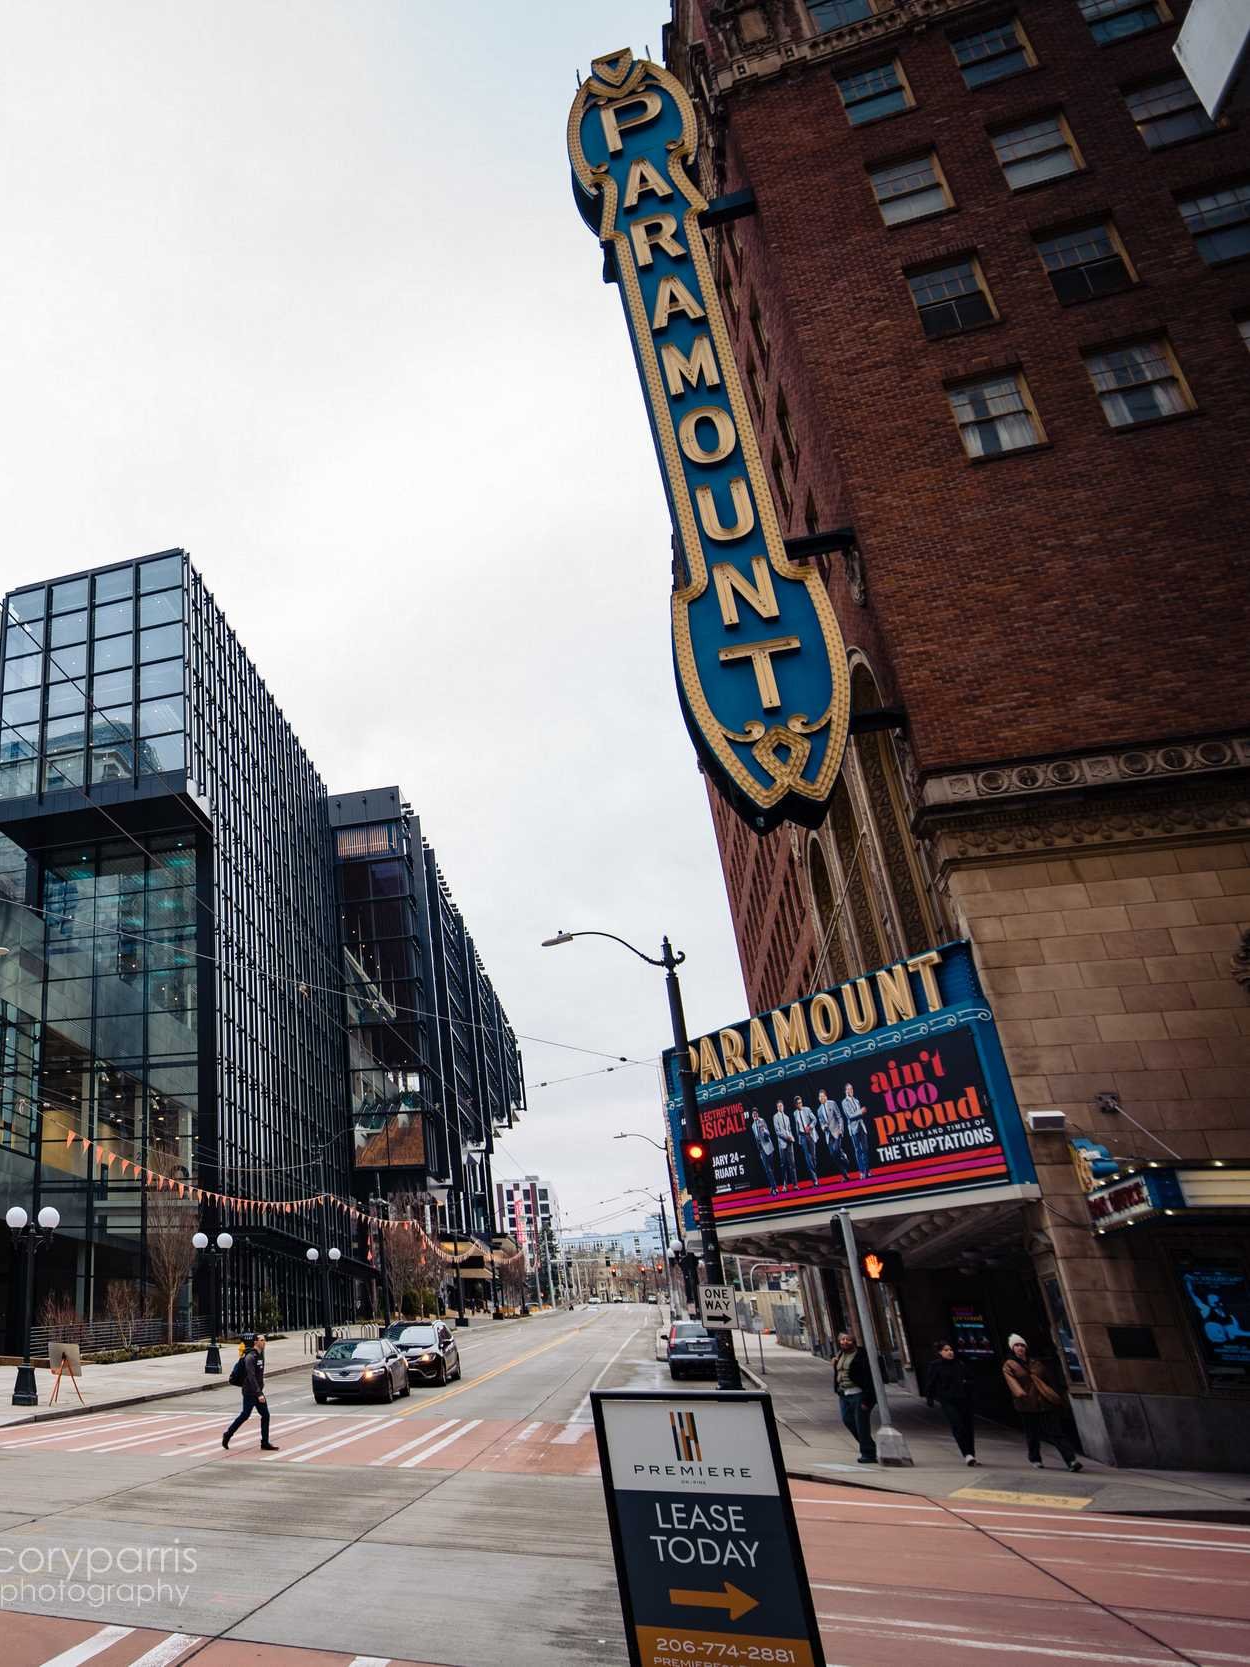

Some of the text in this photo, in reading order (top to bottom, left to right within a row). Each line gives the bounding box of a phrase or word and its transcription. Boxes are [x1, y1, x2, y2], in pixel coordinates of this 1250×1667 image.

[598, 91, 801, 709] PARAMOUNT
[870, 1048, 946, 1093] ain't
[884, 1082, 938, 1112] too
[699, 1103, 743, 1121] LECTRIFYING
[874, 1086, 983, 1146] proud
[908, 1131, 924, 1139] LIFE
[927, 1127, 944, 1136] AND
[947, 1122, 970, 1132] TIMES
[975, 1118, 986, 1126] OF
[876, 1126, 994, 1162] THE TEMPTATIONS
[730, 1152, 739, 1164] 24
[715, 1164, 745, 1180] RUARY 5
[704, 1288, 729, 1299] ONE
[704, 1301, 731, 1311] WAY
[633, 1464, 752, 1478] PREMIERE
[655, 1502, 747, 1532] LEASE
[649, 1535, 759, 1568] TODAY
[655, 1637, 796, 1663] 206-774-2881
